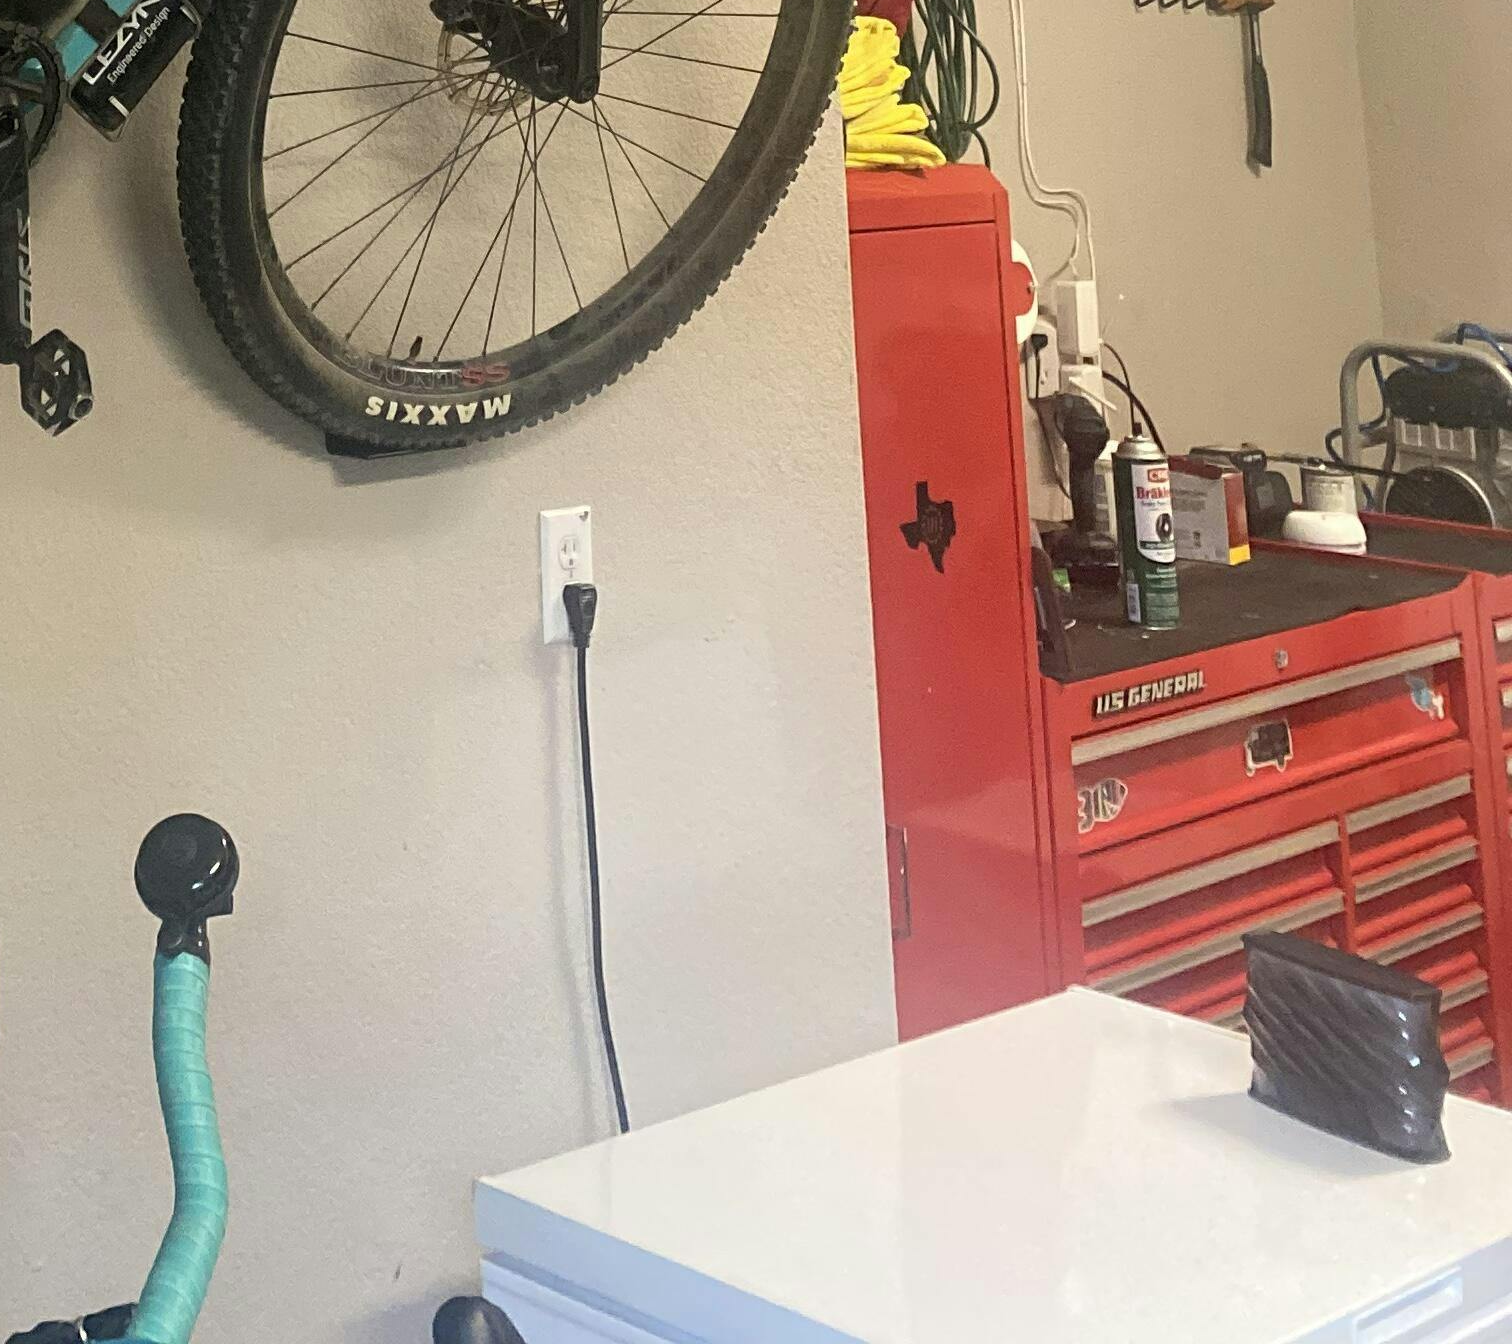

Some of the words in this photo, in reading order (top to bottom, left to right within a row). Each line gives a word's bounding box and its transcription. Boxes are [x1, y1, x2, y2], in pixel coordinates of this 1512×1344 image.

[106, 33, 148, 85] Engineered
[143, 6, 171, 39] Design
[365, 394, 512, 426] MAXXIS
[1128, 670, 1207, 707] GENERAL
